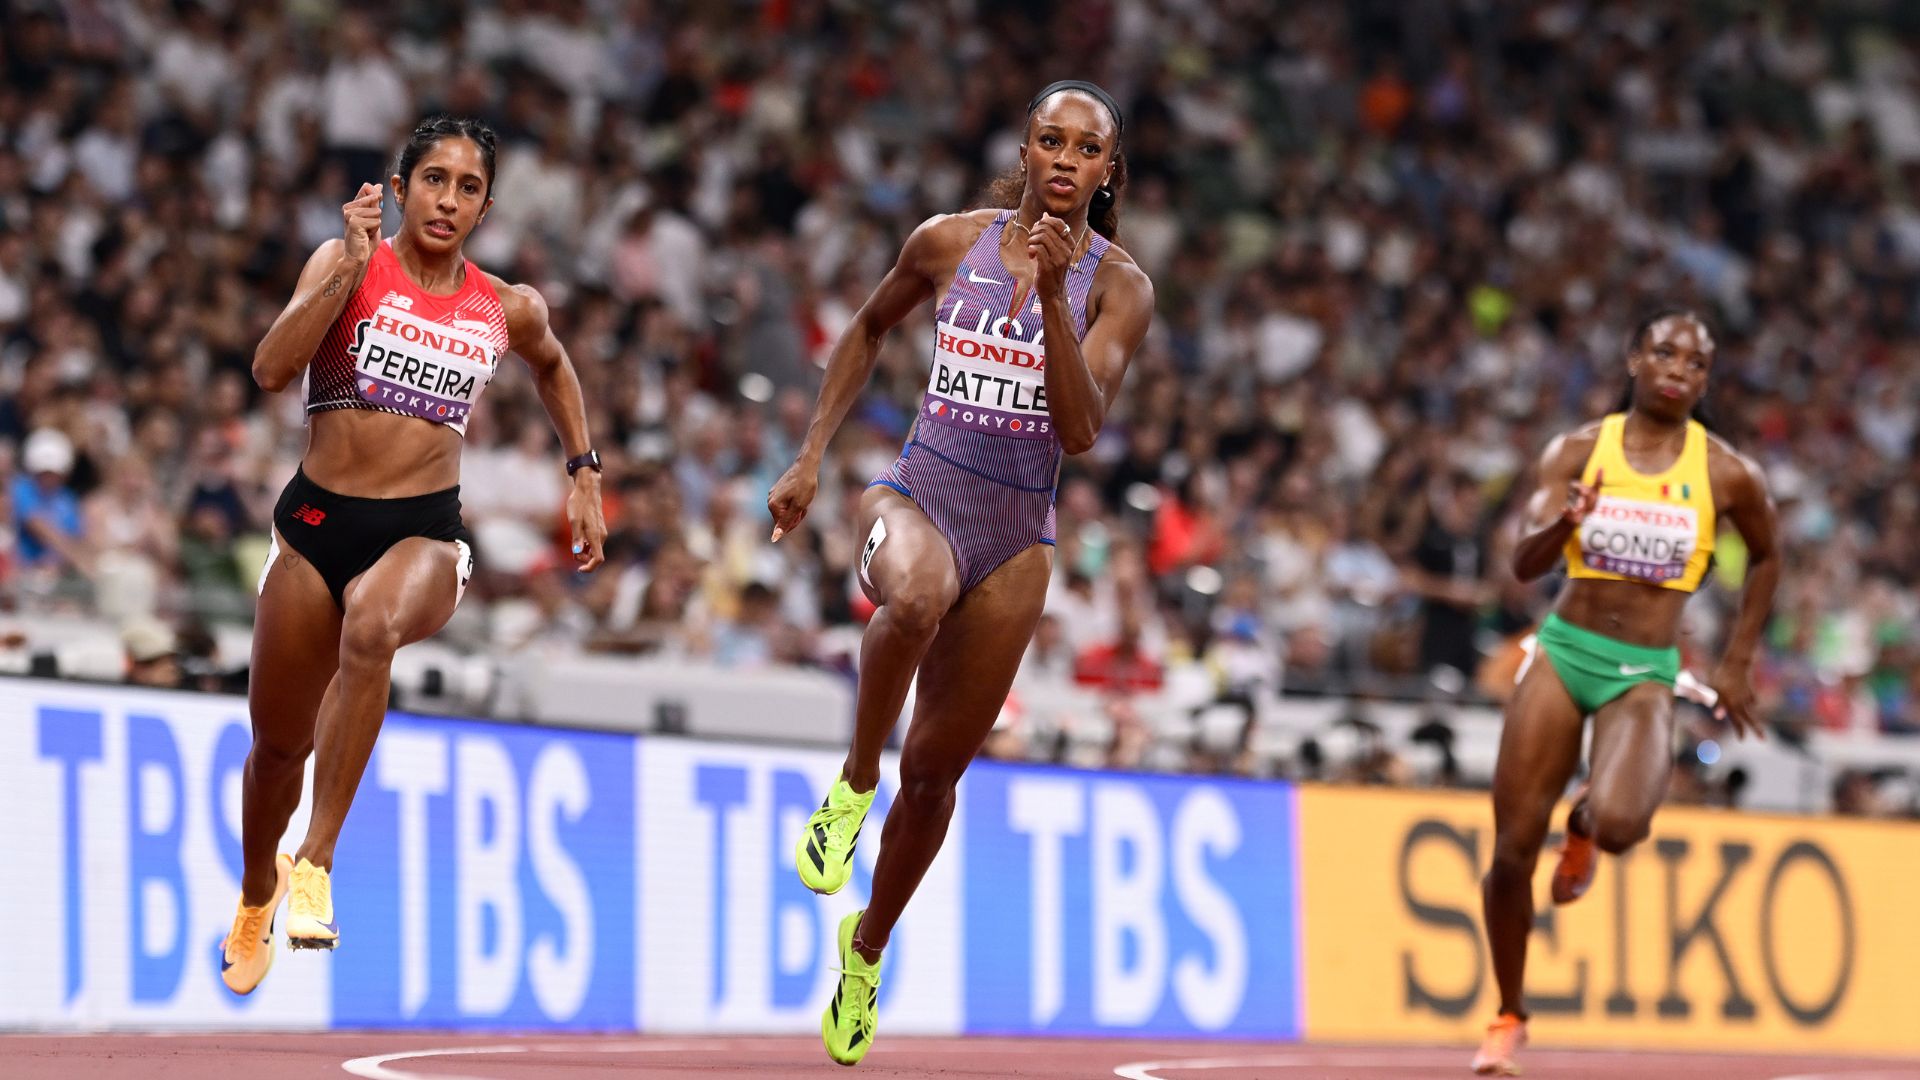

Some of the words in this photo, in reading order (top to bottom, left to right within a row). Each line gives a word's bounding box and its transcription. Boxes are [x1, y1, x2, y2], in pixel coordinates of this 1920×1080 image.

[372, 315, 489, 366] HONDA
[363, 344, 476, 400] PEREIRA
[936, 363, 1048, 412] BATTLE
[1588, 529, 1687, 563] CONDE
[376, 729, 597, 1023] TBS
[1006, 776, 1251, 1032] TBS
